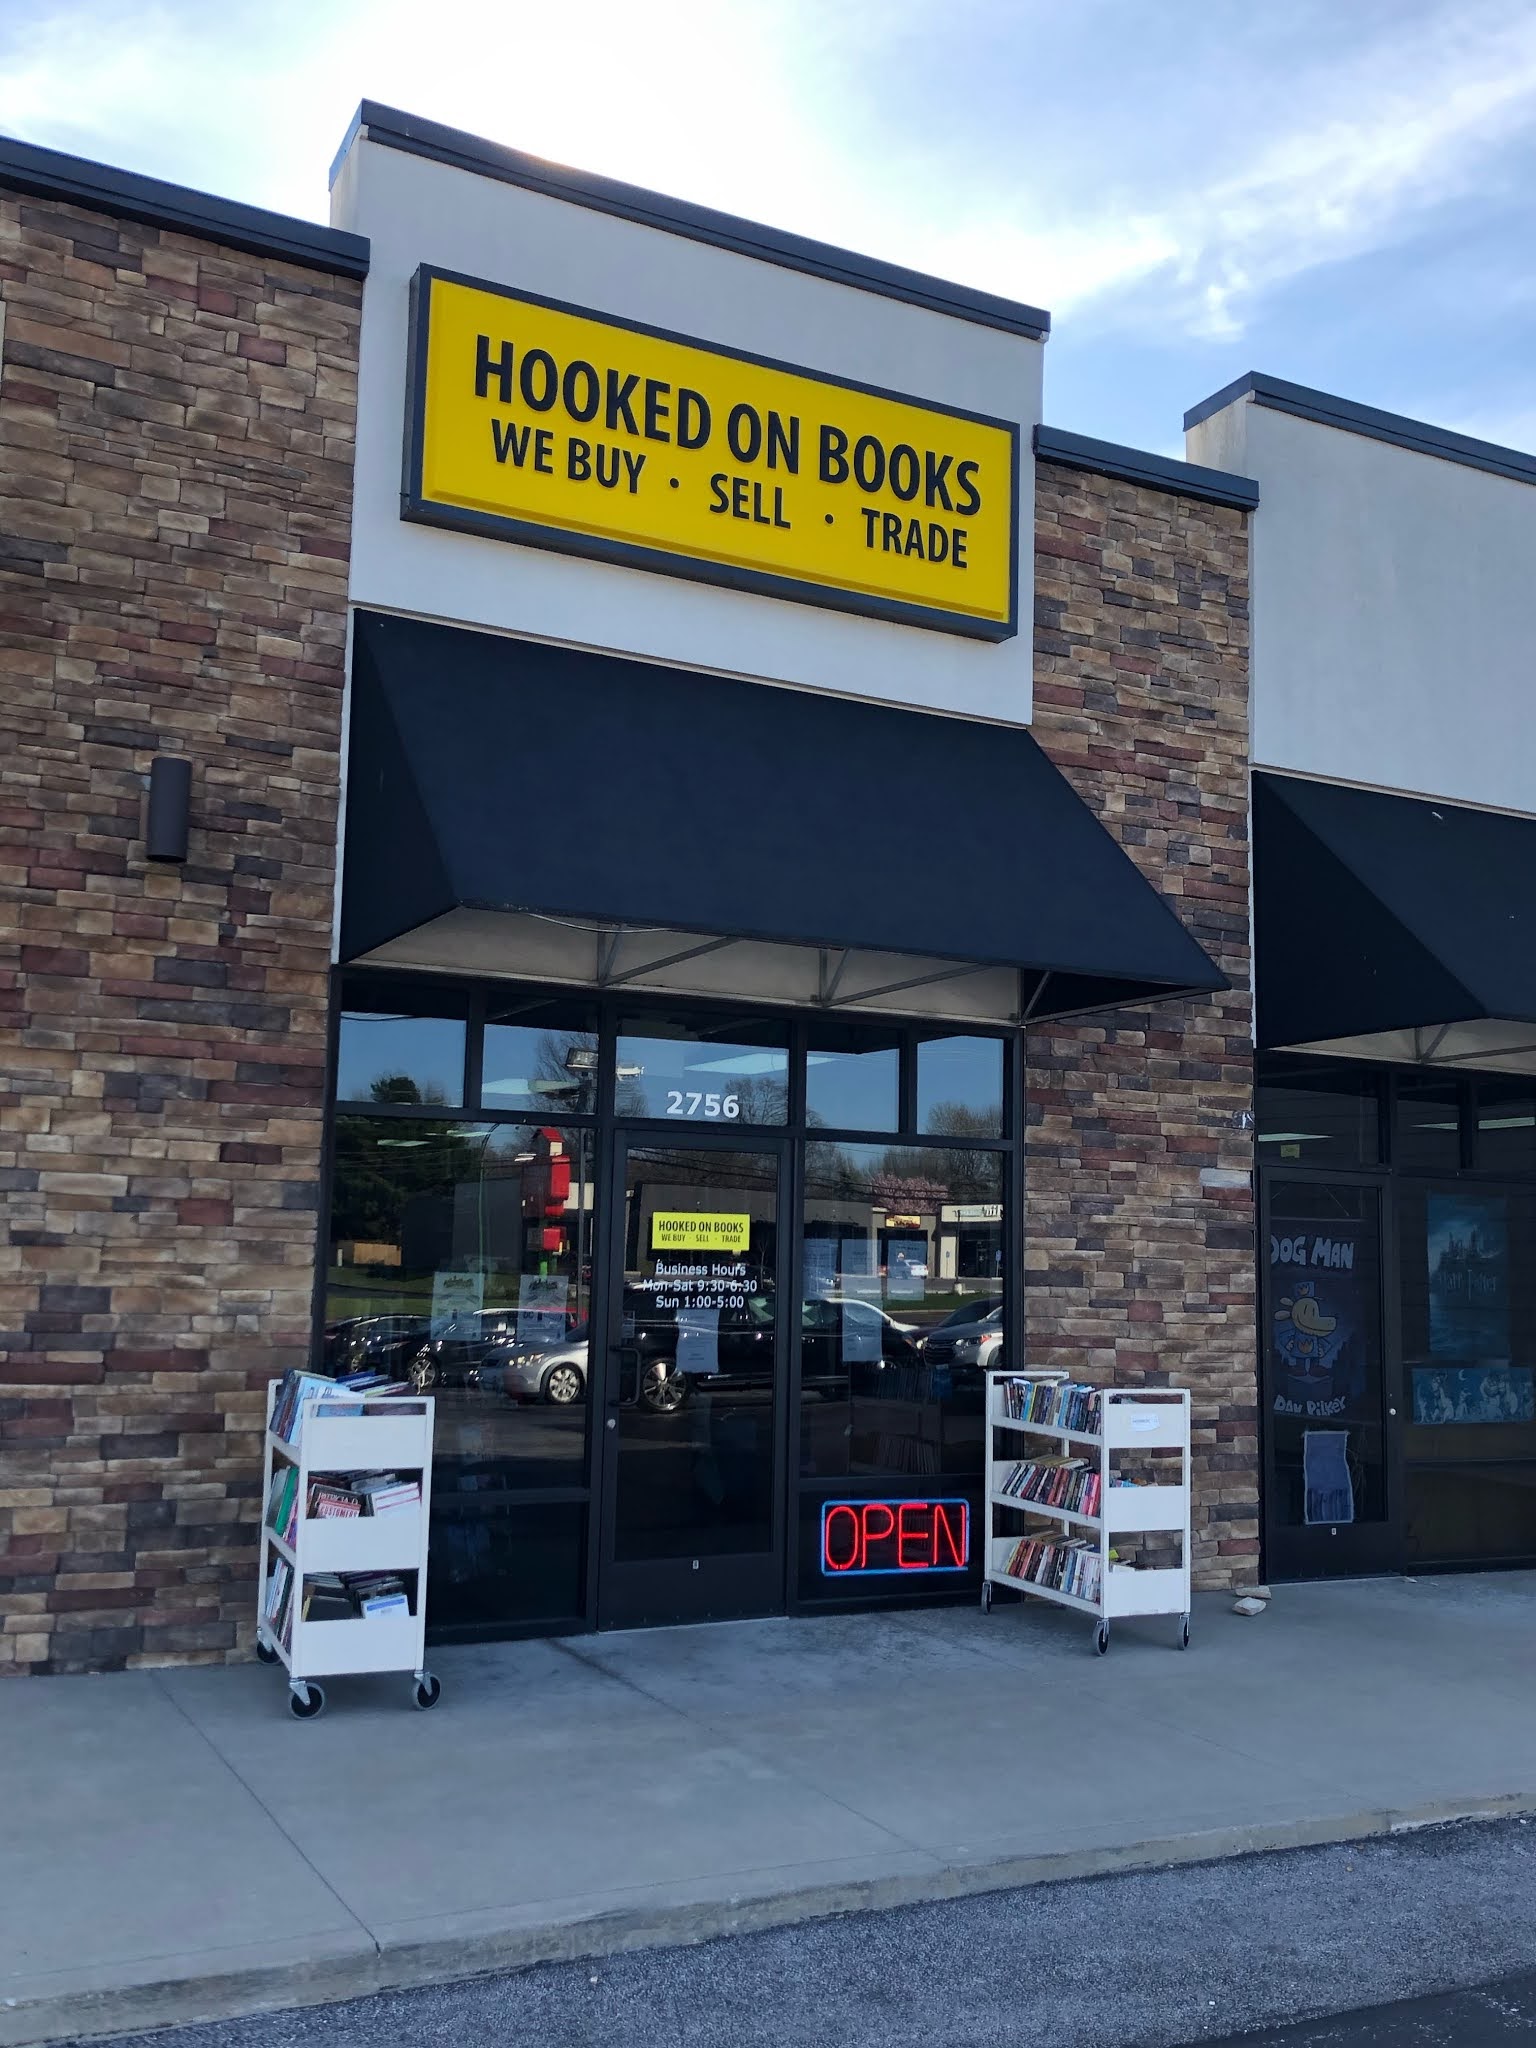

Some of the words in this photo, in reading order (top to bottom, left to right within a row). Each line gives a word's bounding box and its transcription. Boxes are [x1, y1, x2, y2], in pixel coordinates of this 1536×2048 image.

[474, 334, 712, 450] HOOKED
[727, 403, 800, 475] ON
[819, 424, 981, 516] BOOKS
[491, 418, 554, 475] WE
[567, 437, 647, 495] BUY
[709, 473, 791, 530] SELL
[861, 507, 968, 569] TRADE
[666, 1090, 740, 1118] 2756
[658, 1220, 697, 1232] HOOKED
[698, 1221, 712, 1233] ON
[714, 1222, 744, 1234] BOOKS
[661, 1233, 671, 1241] WE
[673, 1234, 686, 1242] BUY
[695, 1234, 709, 1242] SELL
[721, 1235, 741, 1243] TRADE
[1270, 1234, 1307, 1266] DOG
[1310, 1236, 1355, 1269] MAN
[655, 1262, 708, 1276] Business
[712, 1263, 747, 1277] Hours
[643, 1279, 694, 1292] Mon-Sat
[697, 1279, 758, 1293] 9:30-6:30
[655, 1295, 680, 1308] Sun
[684, 1295, 745, 1308] 1:00-5:00
[825, 1502, 967, 1571] OPEN
